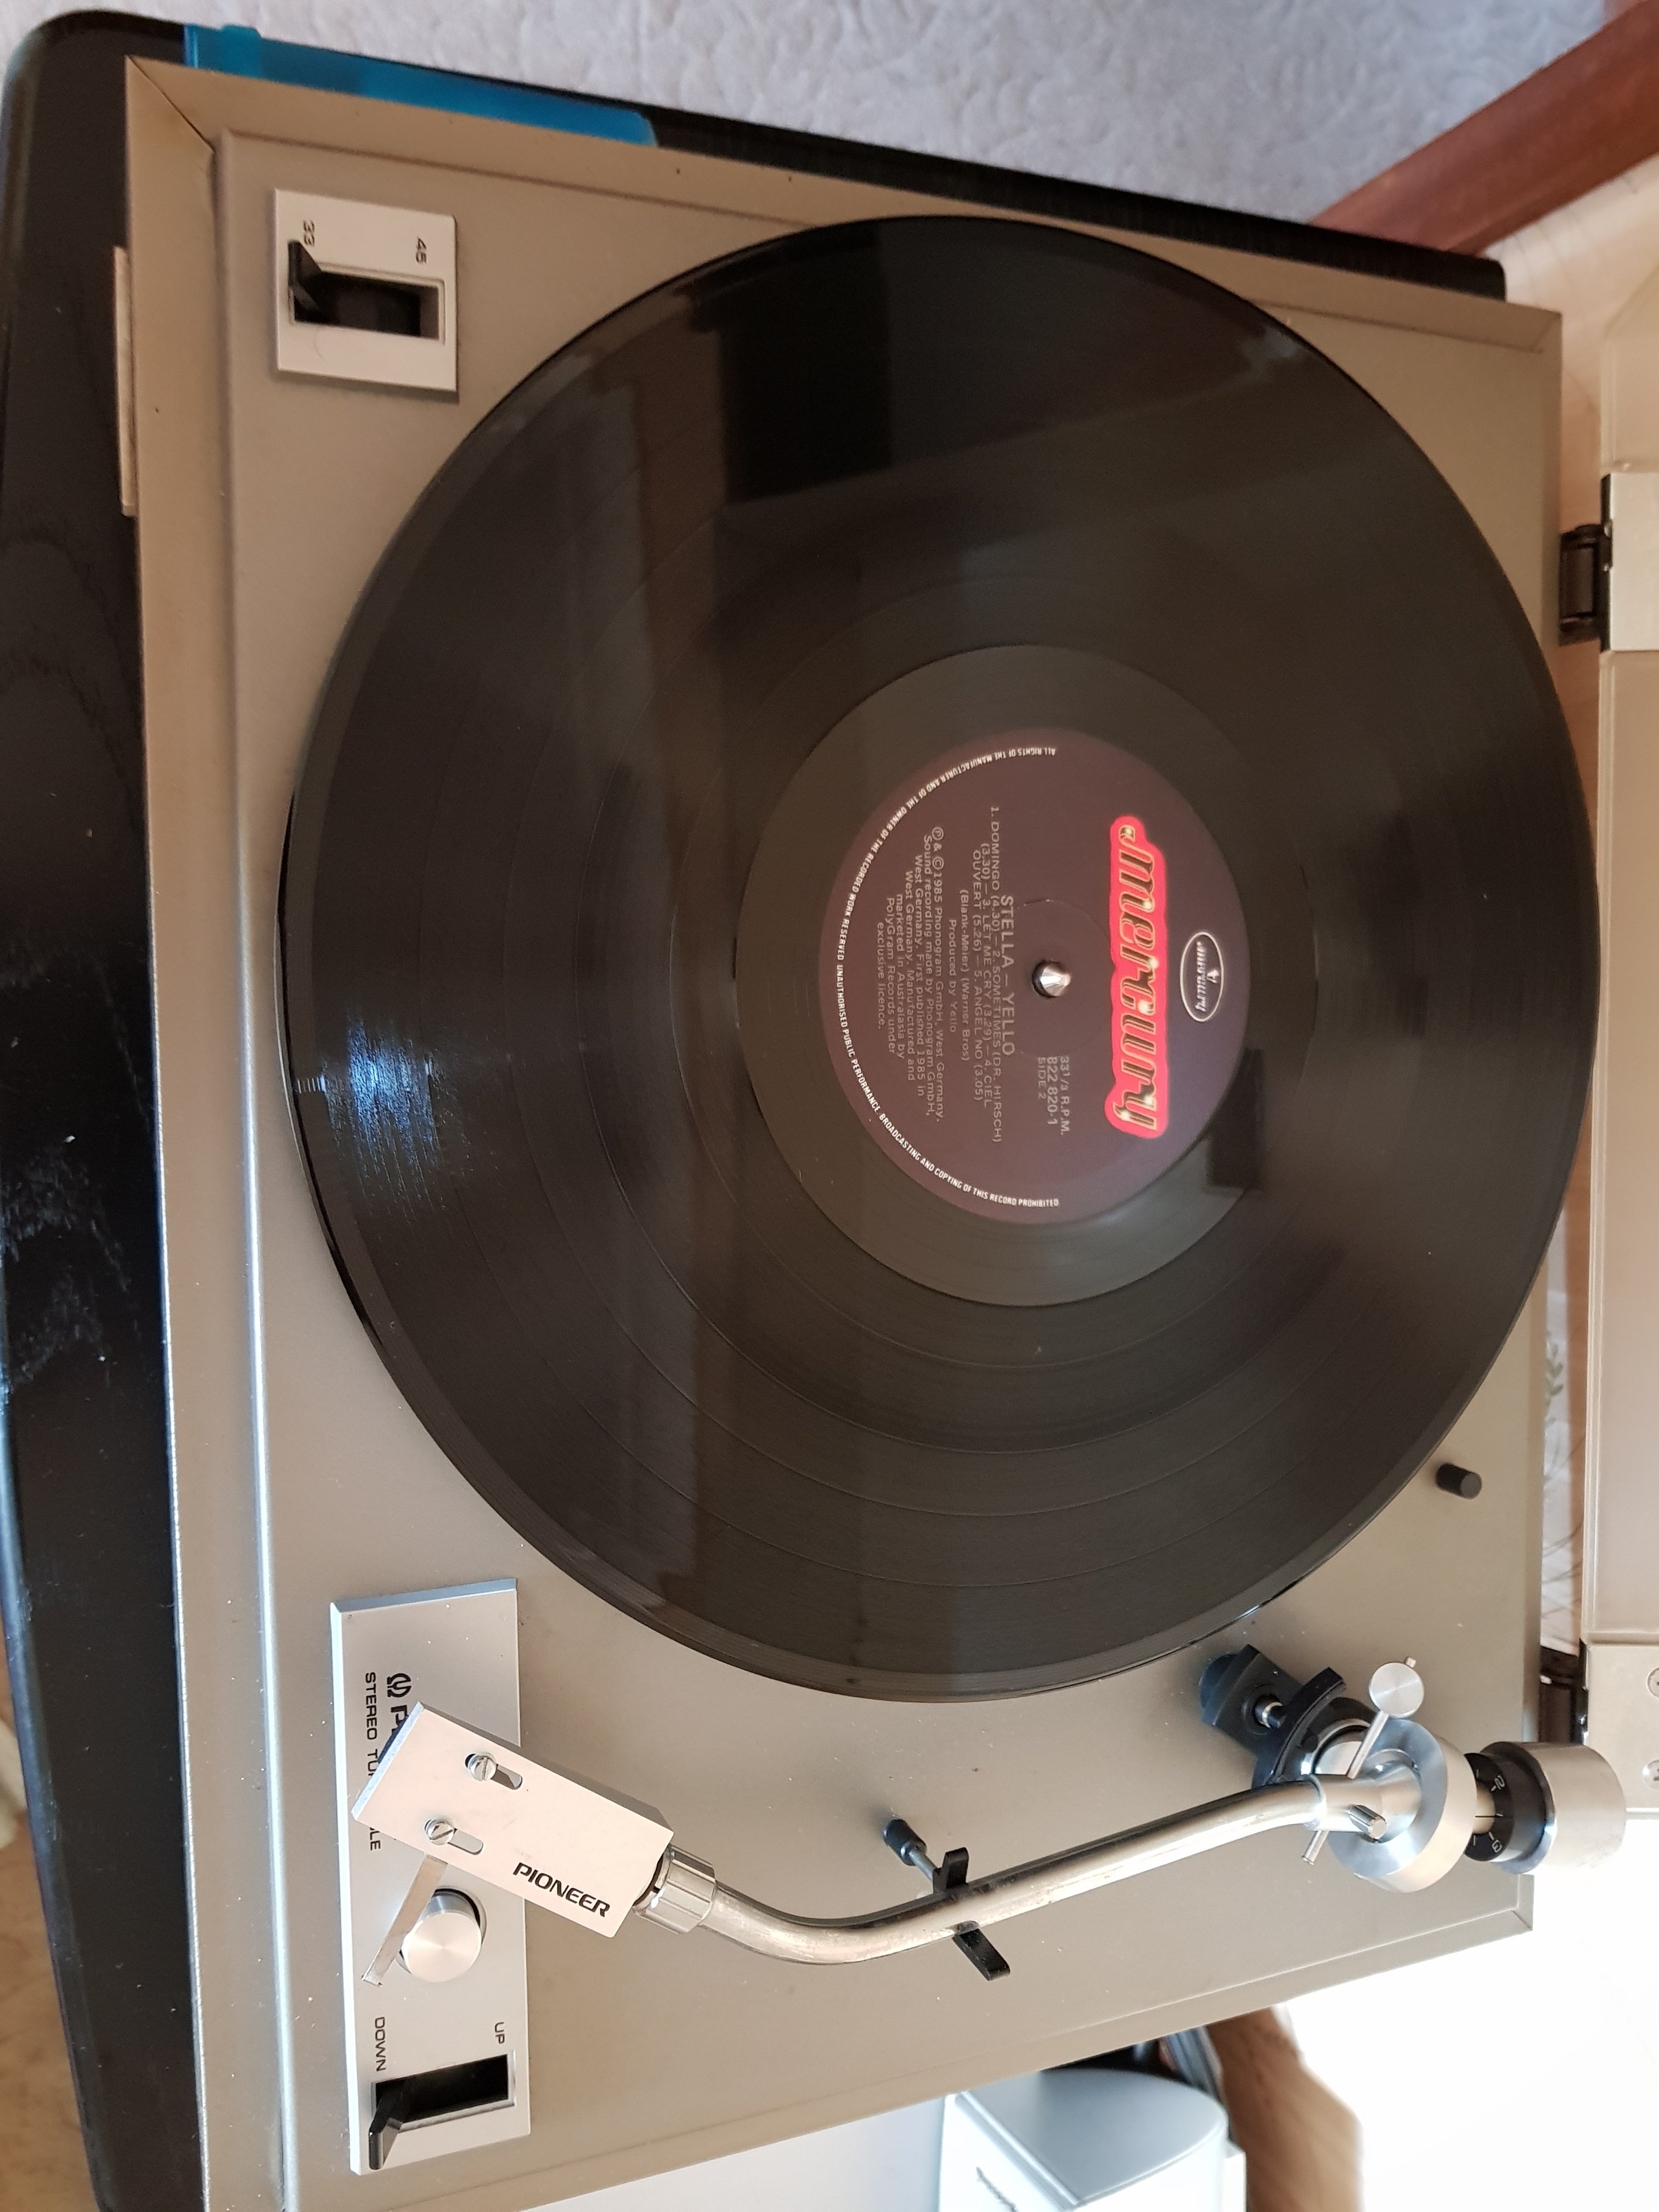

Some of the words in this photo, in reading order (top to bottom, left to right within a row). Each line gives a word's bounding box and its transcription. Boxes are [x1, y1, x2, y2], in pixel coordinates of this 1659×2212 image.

[303, 219, 315, 246] 33
[416, 238, 427, 264] 45
[994, 751, 1006, 760] THE
[1009, 749, 1015, 758] OF
[1018, 746, 1042, 757] RIGHTS
[1044, 747, 1056, 756] ALL
[941, 754, 992, 783] MANUFACTURER
[918, 788, 927, 799] OF
[926, 778, 940, 792] AND
[906, 795, 919, 810] THE
[886, 806, 907, 831] OWNER
[871, 839, 883, 854] THE
[880, 829, 889, 840] OF
[924, 835, 932, 874] Sound
[980, 843, 990, 879] (3.30)
[991, 822, 1000, 890] DOMINGO
[852, 853, 874, 893] RECORDED
[973, 850, 981, 910] OUVERT
[844, 894, 857, 917] WORK
[915, 888, 923, 949] Germany.
[924, 879, 933, 937] recording
[990, 896, 1000, 932] (4.30)
[885, 898, 895, 960] PolyGram
[896, 894, 905, 952] marketed
[905, 904, 914, 964] Germany.
[960, 889, 969, 972] (Blank-Meier)
[972, 915, 981, 951] (5.26)
[983, 915, 991, 941] LET
[1001, 894, 1014, 968] STELLA
[837, 918, 850, 961] RESERVED
[934, 908, 943, 977] Phonogram
[949, 919, 957, 976] Produced
[897, 957, 905, 967] in
[916, 954, 924, 981] First
[983, 946, 991, 966] ME
[837, 965, 848, 1028] UNAUTHORISED
[925, 979, 933, 994] by
[949, 981, 956, 996] by
[961, 978, 970, 1024] (Warner
[983, 971, 992, 1000] CRY
[898, 972, 906, 1039] Australasia
[906, 970, 916, 1054] Manufactured
[916, 987, 924, 1045] published
[935, 981, 944, 1025] GmbH,
[950, 1002, 958, 1033] Yello
[974, 986, 983, 1035] ANGEL
[992, 966, 1001, 1048] SOMETIMES
[888, 1019, 896, 1053] under
[926, 998, 934, 1067] Phonogram
[983, 1006, 992, 1041] (3.29)
[1002, 993, 1015, 1055] YELLO
[843, 1029, 855, 1057] PUBLIC
[897, 1044, 905, 1059] by
[961, 1030, 970, 1061] Bros)
[975, 1040, 983, 1059] NO
[907, 1059, 916, 1081] and
[917, 1051, 925, 1080] 1985
[992, 1052, 1001, 1081] (DR.
[1038, 1057, 1046, 1088] SIDE
[1047, 1057, 1058, 1082] 822
[917, 1086, 925, 1096] in
[926, 1072, 935, 1116] GmbH,
[935, 1063, 945, 1122] Germany.
[974, 1064, 983, 1101] (3.05)
[984, 1076, 992, 1108] CIEL
[992, 1086, 1002, 1142] HIRSCH)
[1047, 1087, 1058, 1125] 820-1
[1060, 1096, 1070, 1136] R.P.M.
[879, 1113, 920, 1161] BROADCASTING
[920, 1158, 935, 1172] AND
[934, 1169, 962, 1189] COPYING
[963, 1184, 972, 1193] OF
[973, 1188, 989, 1200] THIS
[990, 1193, 1017, 1206] RECORD
[1018, 1198, 1058, 1207] PROHIBITED
[365, 1672, 377, 1740] STEREO
[1494, 1775, 1505, 1790] 2
[512, 1862, 610, 1917] PIONEER
[375, 2017, 387, 2072] DOWN
[495, 2022, 505, 2044] UP
